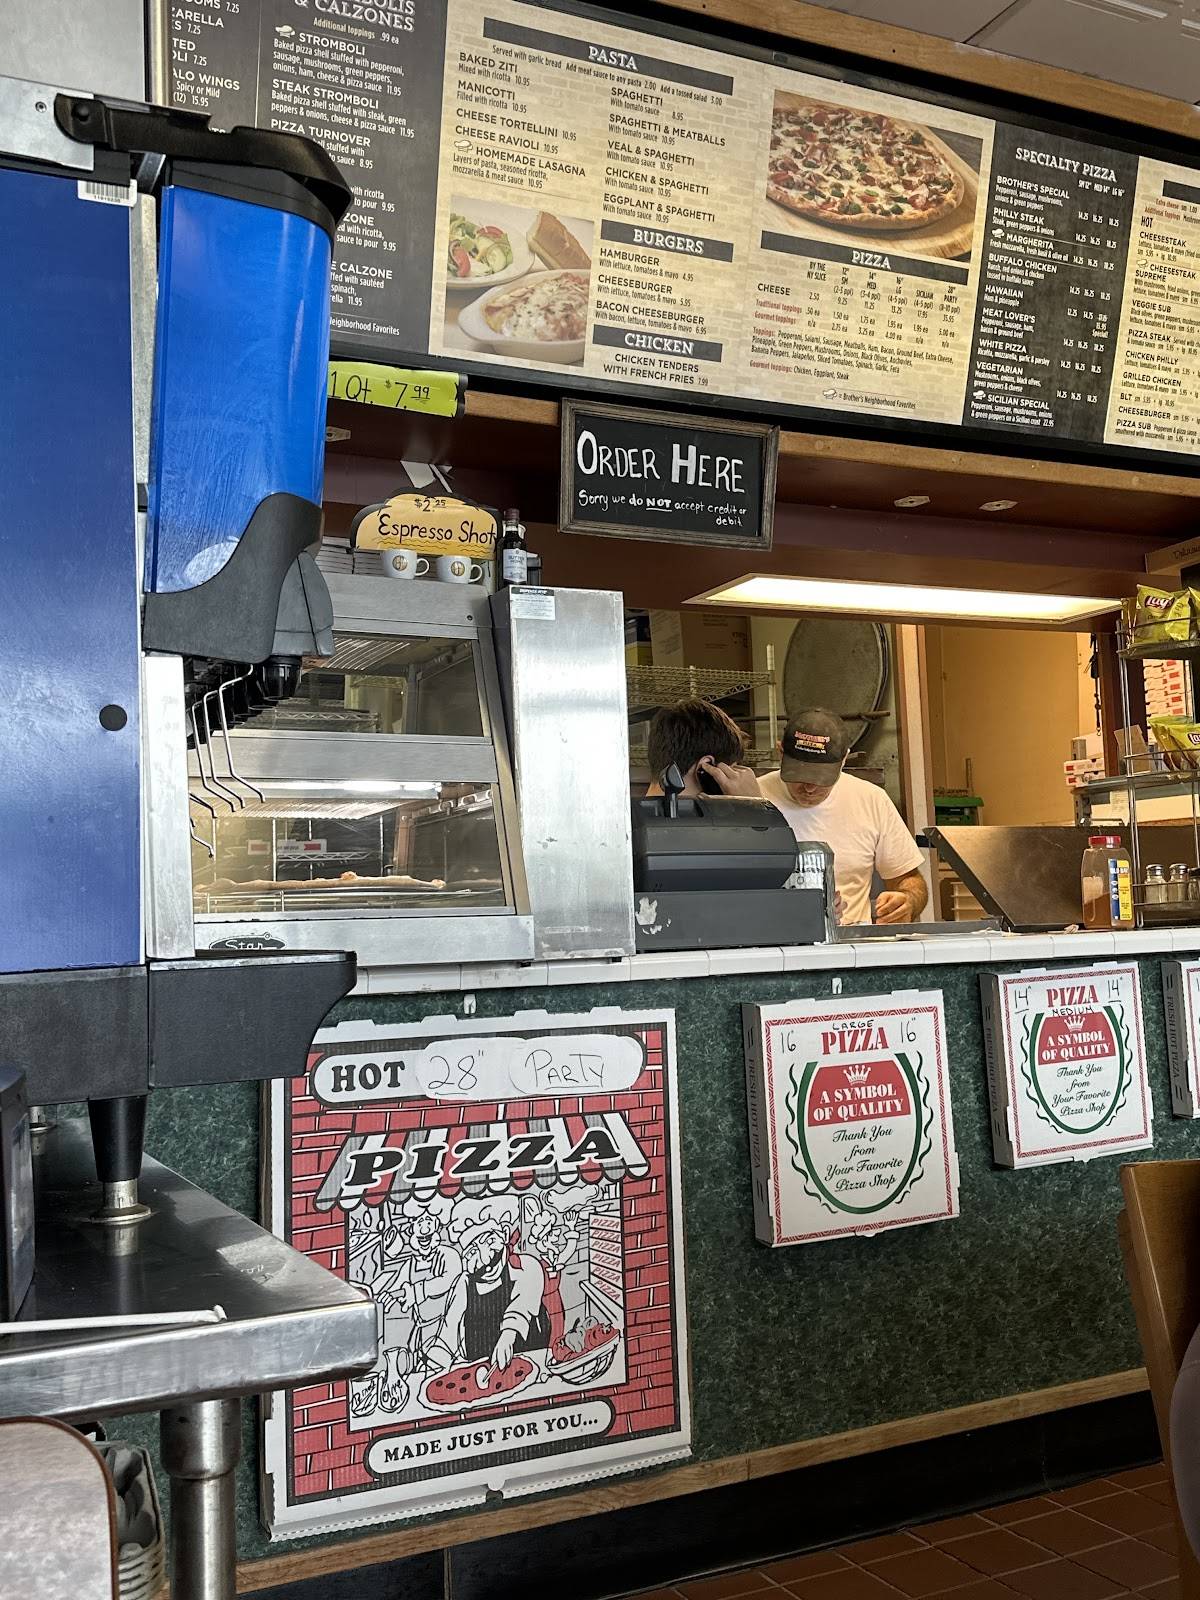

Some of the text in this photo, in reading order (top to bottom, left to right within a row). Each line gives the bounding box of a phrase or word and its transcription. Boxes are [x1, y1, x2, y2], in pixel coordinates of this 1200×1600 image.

[226, 1, 239, 13] 7.25
[315, 0, 414, 32] CALZONES
[187, 23, 200, 34] 7.25
[299, 32, 364, 55] STROMBOLI
[193, 54, 206, 66] 7.25
[274, 38, 404, 76] Baked pizza shell stuffed with pepperoni,
[459, 52, 517, 72] BAKED ZITI
[588, 46, 637, 70] PASTA
[273, 50, 392, 87] sausage, mushrooms, green peppers,
[458, 62, 529, 86] Mixed with ricotta 10.95
[176, 80, 219, 97] Spicy or Mild
[198, 73, 239, 90] WINGS
[458, 80, 514, 100] MANICOTTI
[173, 91, 208, 106] (12) 15.95
[272, 78, 378, 108] STEAK STROMBOLI
[611, 87, 662, 106] SPAGHETTI
[271, 118, 370, 146] PIZZA TURNOVER
[456, 107, 576, 141] CHEESE TORTELLINI 10.95
[609, 113, 725, 146] SPAGHETTI & MEATBALLS
[455, 125, 495, 141] CHEESE
[498, 134, 539, 150] RAVIOLI
[476, 146, 585, 176] HOMEMADE LASAGNA
[607, 139, 694, 165] VEAL & SPAGHETTI
[1015, 147, 1116, 182] SPECIALTY PIZZA
[605, 166, 708, 194] CHICKEN & SPAGHETTI
[997, 175, 1069, 198] BROTHER'S SPECIAL
[604, 193, 714, 222] EGGPLANT & SPAGHETTI
[993, 207, 1044, 225] PHILLY STEAK
[633, 228, 703, 254] BURGERS
[1006, 233, 1053, 250] MARGHERITA
[1139, 231, 1186, 247] CHEESESTEAK
[600, 247, 659, 266] HAMBURGER
[852, 250, 891, 270] PIZZA
[989, 253, 1056, 273] BUFFALO CHICKEN
[339, 262, 392, 279] CALZONE
[598, 274, 672, 294] CHEESEBURGER
[757, 283, 790, 295] CHEESE
[985, 284, 1023, 298] HAWAIIAN
[596, 300, 704, 324] BACON CHEESEBURGER
[982, 307, 1035, 323] MEAT LOVER'S
[1132, 299, 1171, 312] VEGGIE SUB
[624, 332, 693, 354] CHICKEN
[1128, 328, 1170, 342] PIZZA STEAK
[979, 338, 1026, 353] WHITE PIZZA
[614, 353, 698, 372] CHICKEN TENDERS
[976, 360, 1023, 374] VEGETARIAN
[1125, 350, 1178, 365] CHICKEN PHILLY
[603, 363, 627, 374] WITH
[630, 367, 666, 380] FRENCH
[669, 373, 694, 384] FRIES
[1122, 371, 1181, 386] GRILLED CHICKEN
[330, 371, 341, 398] 1
[346, 375, 373, 404] Qt.
[987, 394, 1049, 410] SICILIAN SPECIAL
[1118, 405, 1170, 419] CHEESEBURGER
[577, 430, 745, 493] ORDER HERE
[578, 490, 608, 511] Sorry
[612, 495, 625, 504] we
[629, 494, 643, 505] do
[646, 499, 672, 508] NOT
[674, 501, 705, 514] accept
[707, 504, 737, 515] credit
[379, 514, 497, 544] Espresso Shot
[716, 516, 743, 526] debit
[1046, 985, 1099, 1007] PIZZA
[1052, 1005, 1094, 1017] MEDIUM
[832, 1020, 874, 1030] LARGE
[822, 1027, 889, 1055] PIZZA
[1047, 1030, 1106, 1046] A SYMBOL
[1042, 1043, 1111, 1061] OF QUALITY
[428, 1050, 485, 1090] 28"
[1056, 1063, 1103, 1078] Thank You
[1172, 1051, 1180, 1078] PIZZA
[332, 1061, 405, 1093] HOT
[747, 1058, 756, 1100] FRESH
[1066, 1078, 1090, 1093] from
[820, 1084, 896, 1104] A SYMBOL
[1052, 1090, 1111, 1108] Your Favorite
[813, 1099, 903, 1121] OF QUALITY
[1060, 1102, 1106, 1116] Pizza Shop
[832, 1125, 893, 1142] Thank You
[344, 1130, 620, 1186] PIZZA
[751, 1134, 760, 1168] PIZZA
[844, 1145, 876, 1161] from
[825, 1158, 904, 1181] Your Favorite
[834, 1174, 896, 1192] Pizza Shop
[591, 1218, 620, 1229] PIZZA
[592, 1230, 620, 1241] PIZZA
[592, 1241, 620, 1253] PIZZA
[592, 1254, 620, 1267] PIZZA
[592, 1267, 620, 1282] PIZZA
[594, 1280, 620, 1300] PIZZA
[384, 1440, 442, 1463] MADE
[447, 1430, 496, 1451] JUST
[501, 1422, 539, 1440] FOR
